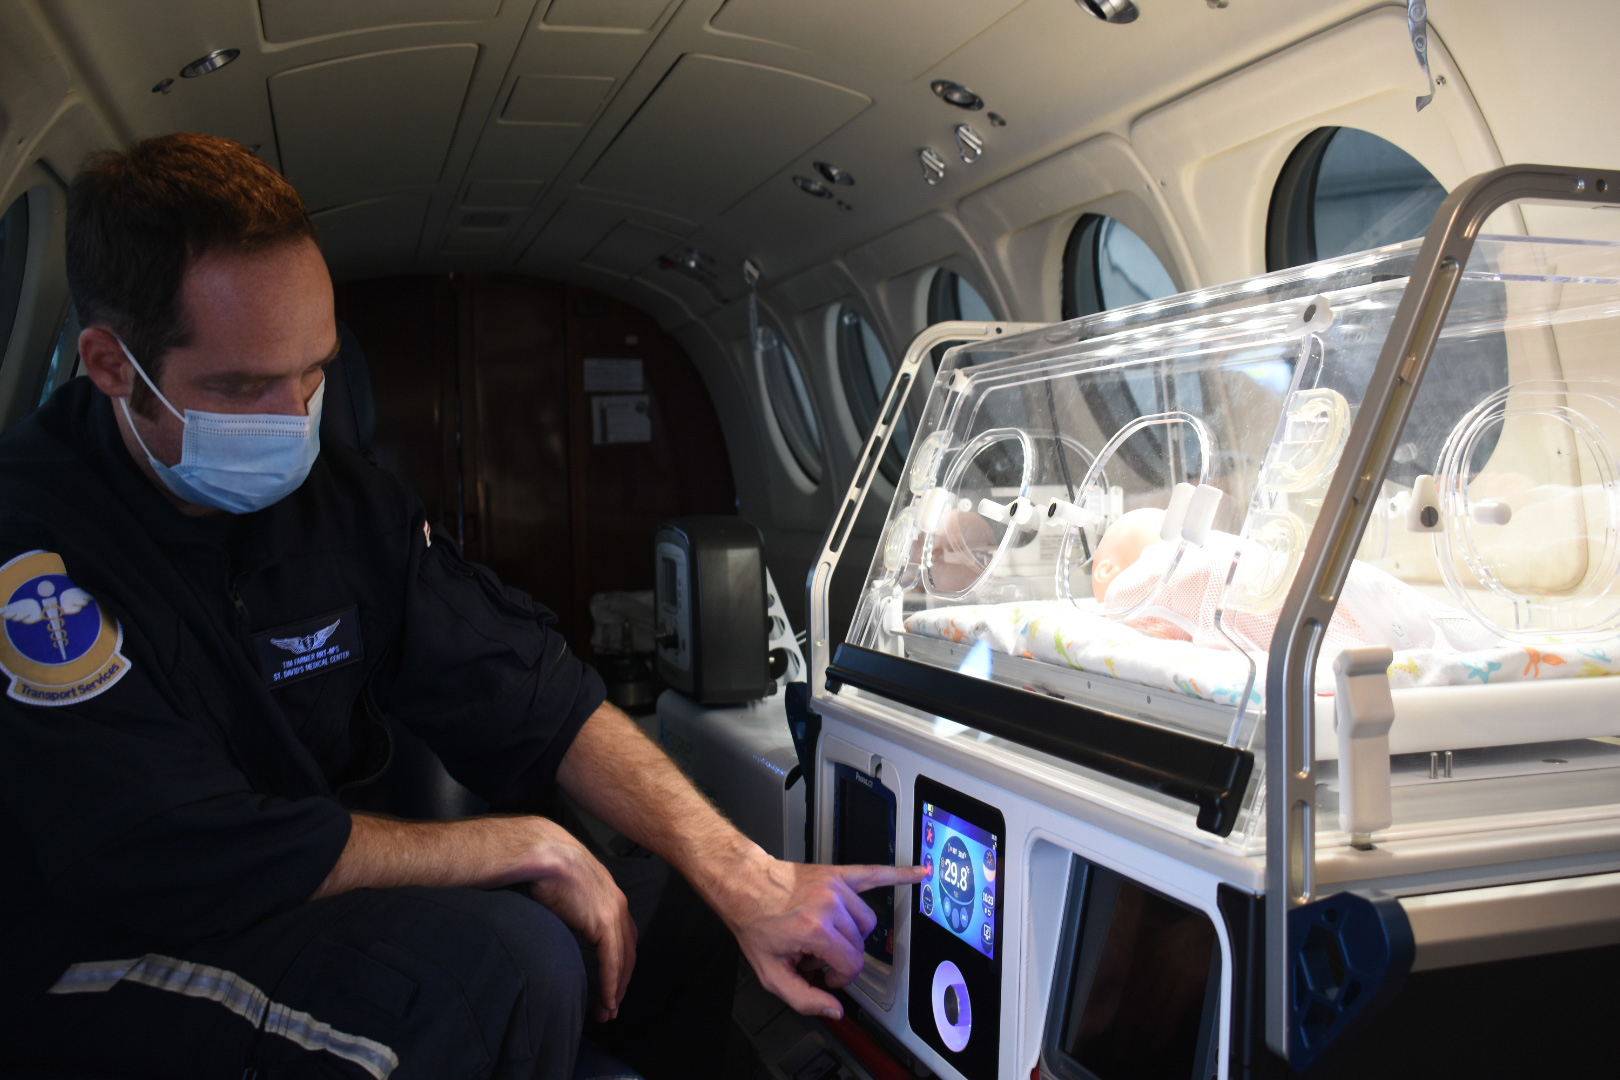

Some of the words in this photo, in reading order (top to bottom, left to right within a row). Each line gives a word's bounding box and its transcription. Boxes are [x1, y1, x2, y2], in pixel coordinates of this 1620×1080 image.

[282, 659, 293, 669] TIM
[294, 653, 316, 666] FARMER
[305, 657, 329, 671] MEDICAL
[329, 650, 350, 664] CENTER
[22, 684, 77, 701] Transport
[77, 663, 120, 695] Services
[944, 858, 968, 891] 29.8
